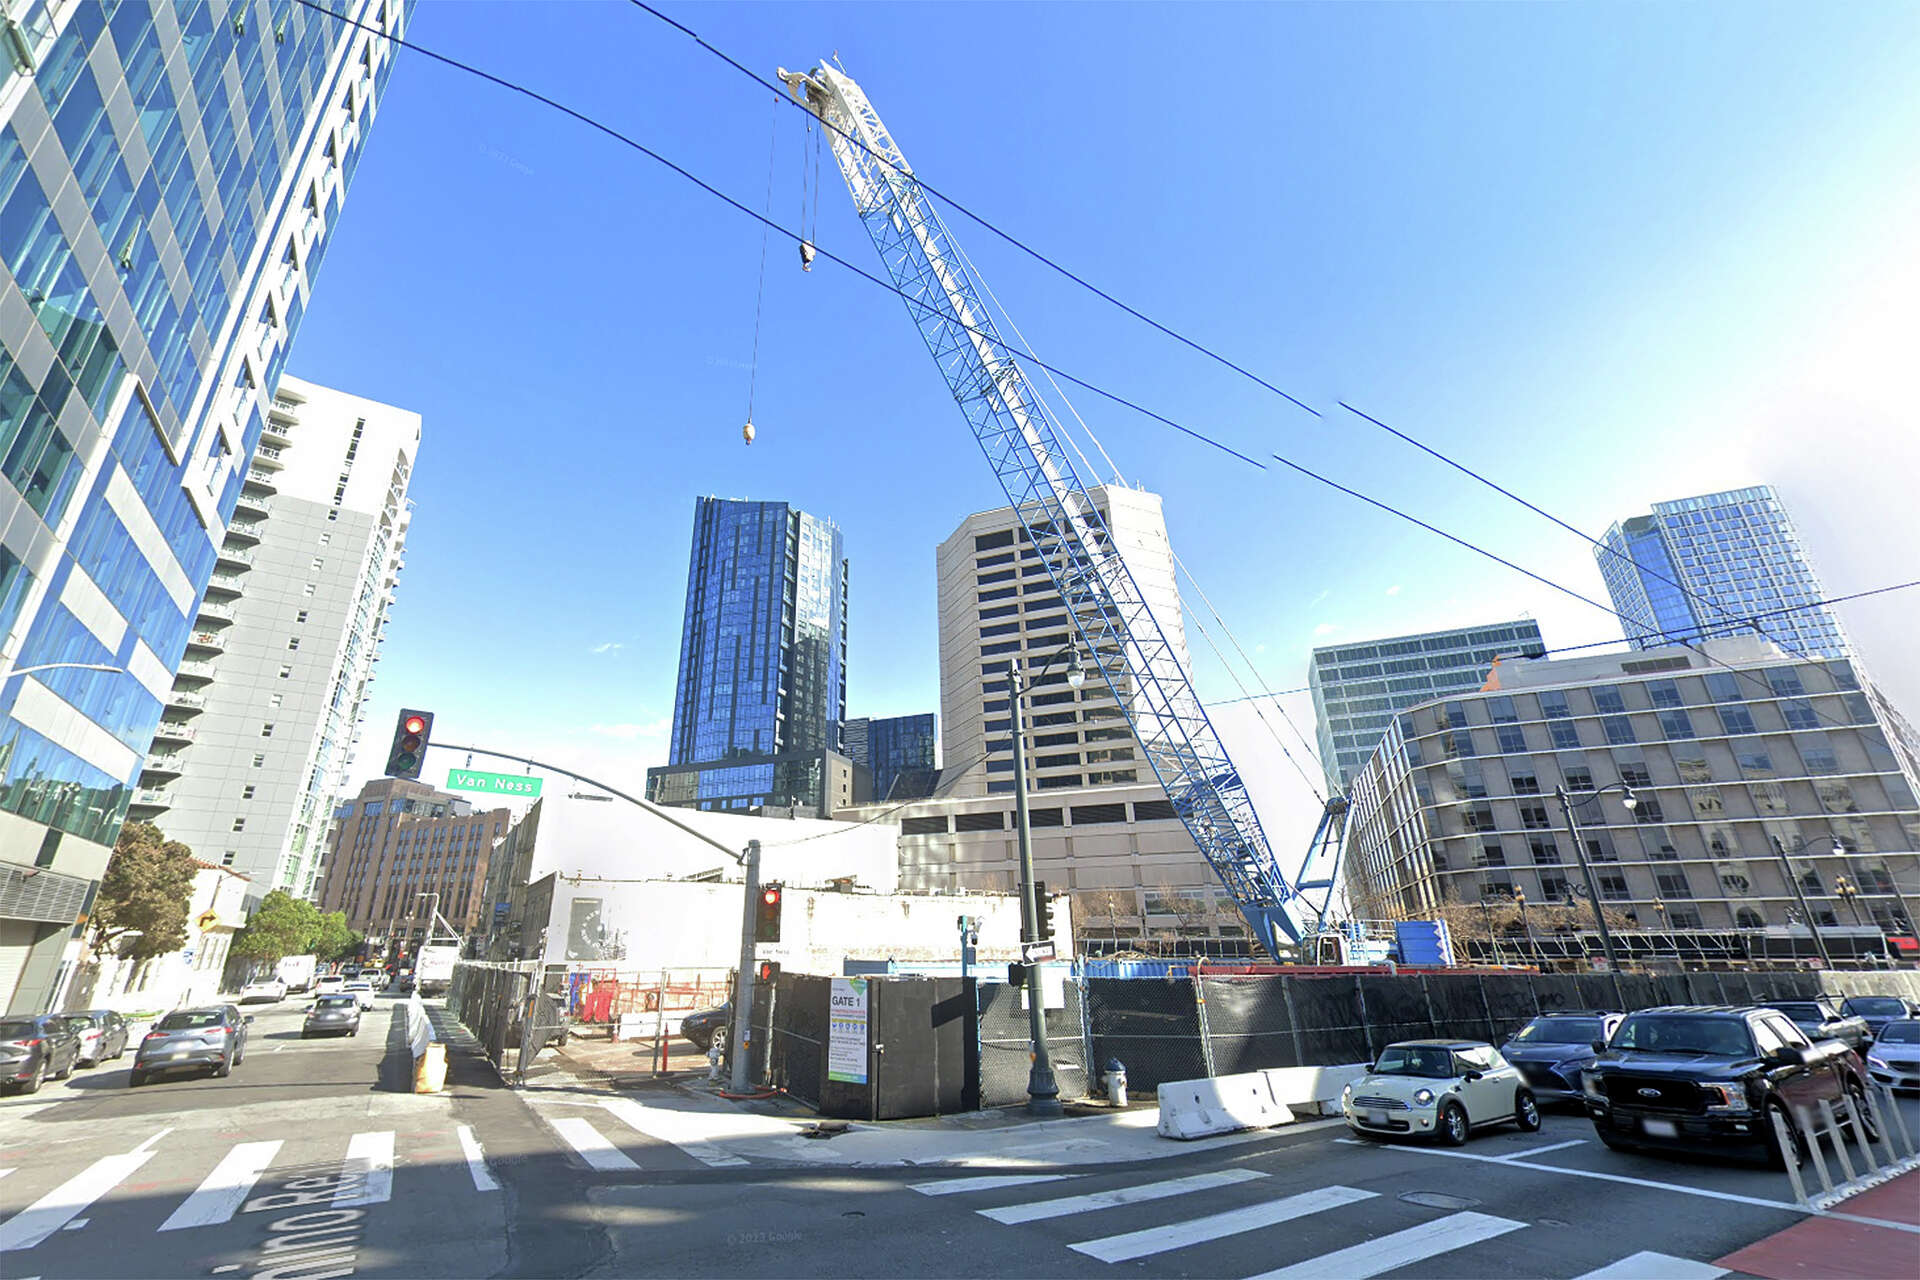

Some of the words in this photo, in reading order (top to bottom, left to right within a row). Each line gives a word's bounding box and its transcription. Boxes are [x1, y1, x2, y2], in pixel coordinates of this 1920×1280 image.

[456, 773, 487, 788] Van
[495, 778, 532, 793] Ness
[831, 995, 854, 1007] GATE
